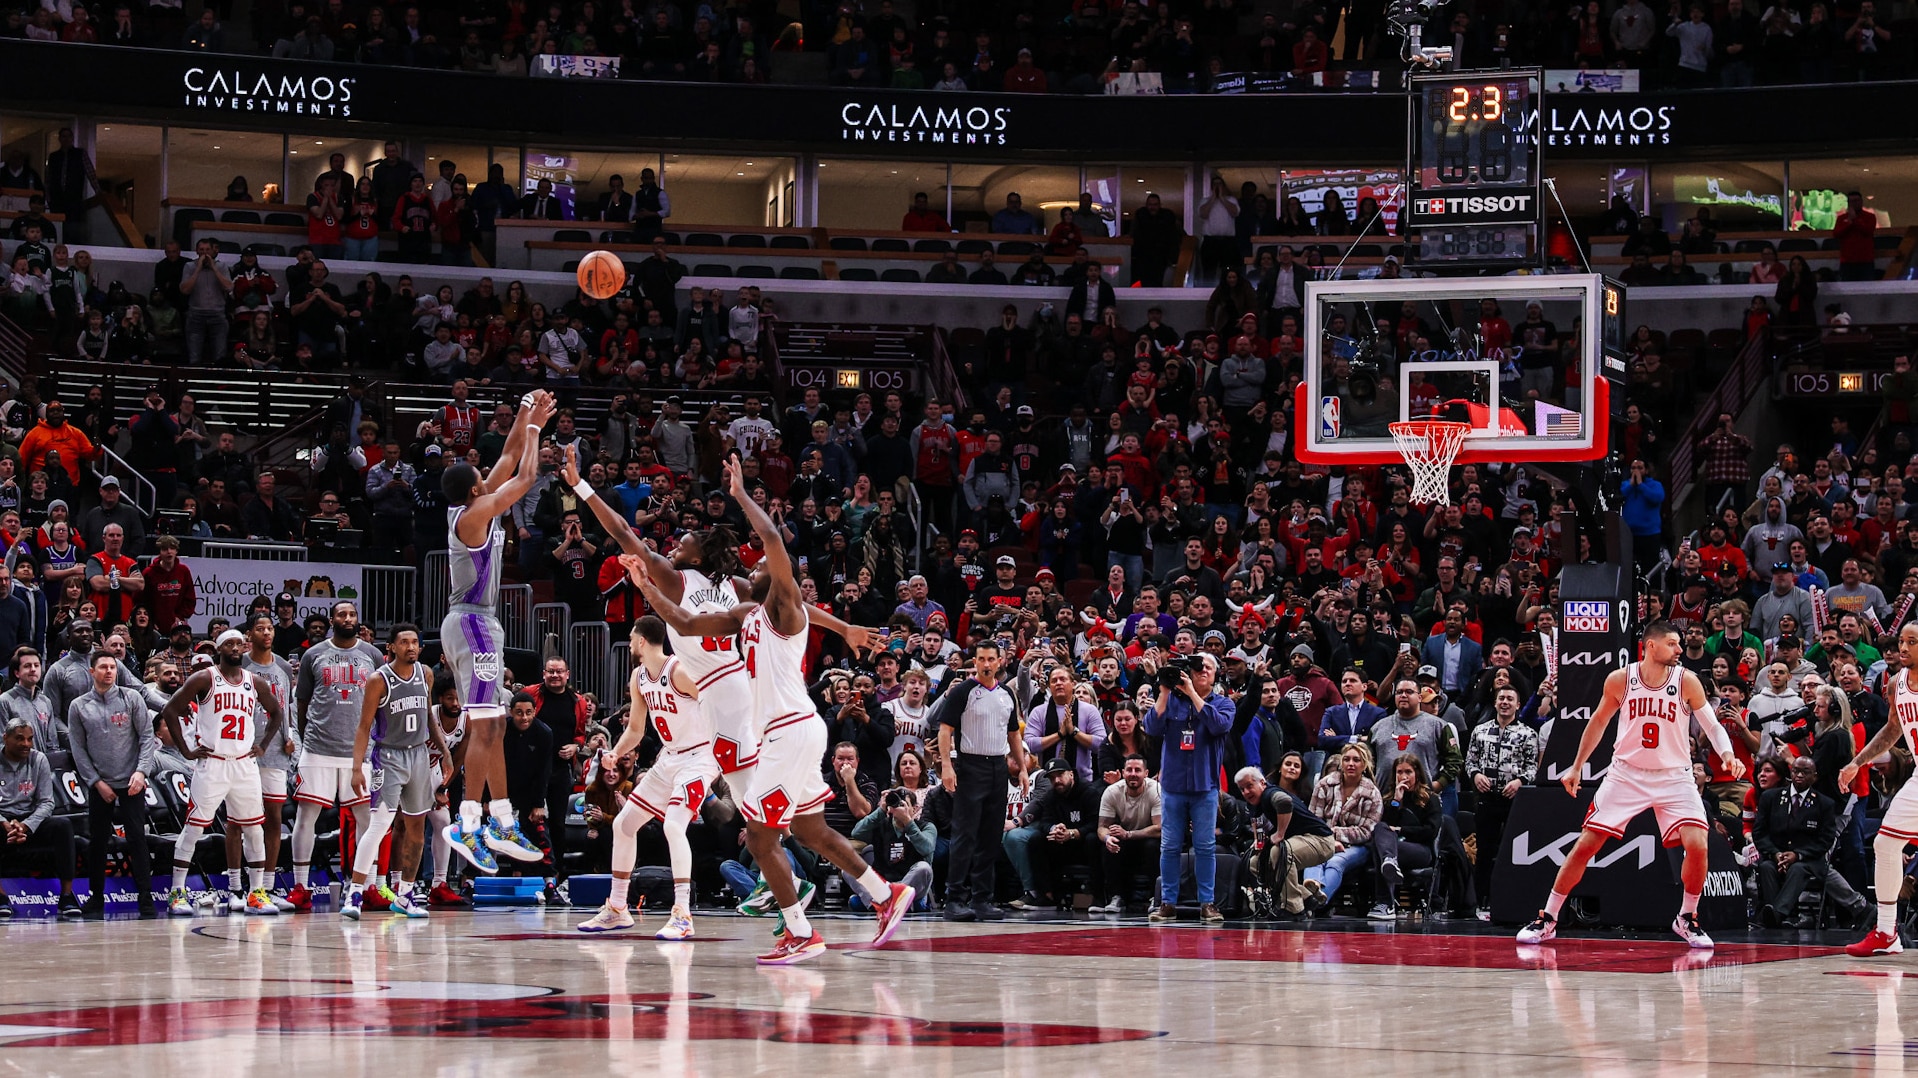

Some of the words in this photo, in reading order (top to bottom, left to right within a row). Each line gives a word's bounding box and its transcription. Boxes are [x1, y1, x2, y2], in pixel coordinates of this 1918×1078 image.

[184, 68, 351, 101] CALAMOS
[186, 95, 351, 116] INVESTMENTS
[1450, 87, 1500, 120] 2.3
[842, 103, 1006, 131] CALAMOS
[1502, 107, 1671, 132] ALAMOS
[843, 129, 1006, 145] INVESTMENTS
[1447, 197, 1530, 213] TISSOT
[790, 368, 827, 388] 104
[838, 371, 859, 388] EXIT
[869, 370, 904, 389] 105
[1794, 374, 1830, 393] 105
[1840, 375, 1862, 391] EXIT
[454, 430, 471, 445] 23
[572, 560, 585, 579] 3
[194, 574, 274, 597] Advocate
[1566, 602, 1607, 616] LIQUI
[1566, 617, 1608, 631] MOLY
[322, 664, 367, 688] BULLS
[214, 692, 254, 717] BULLS
[1628, 697, 1677, 723] BULLS
[220, 714, 246, 741] 21
[405, 713, 417, 733] 0
[655, 716, 673, 742] 8
[1641, 722, 1660, 749] 9
